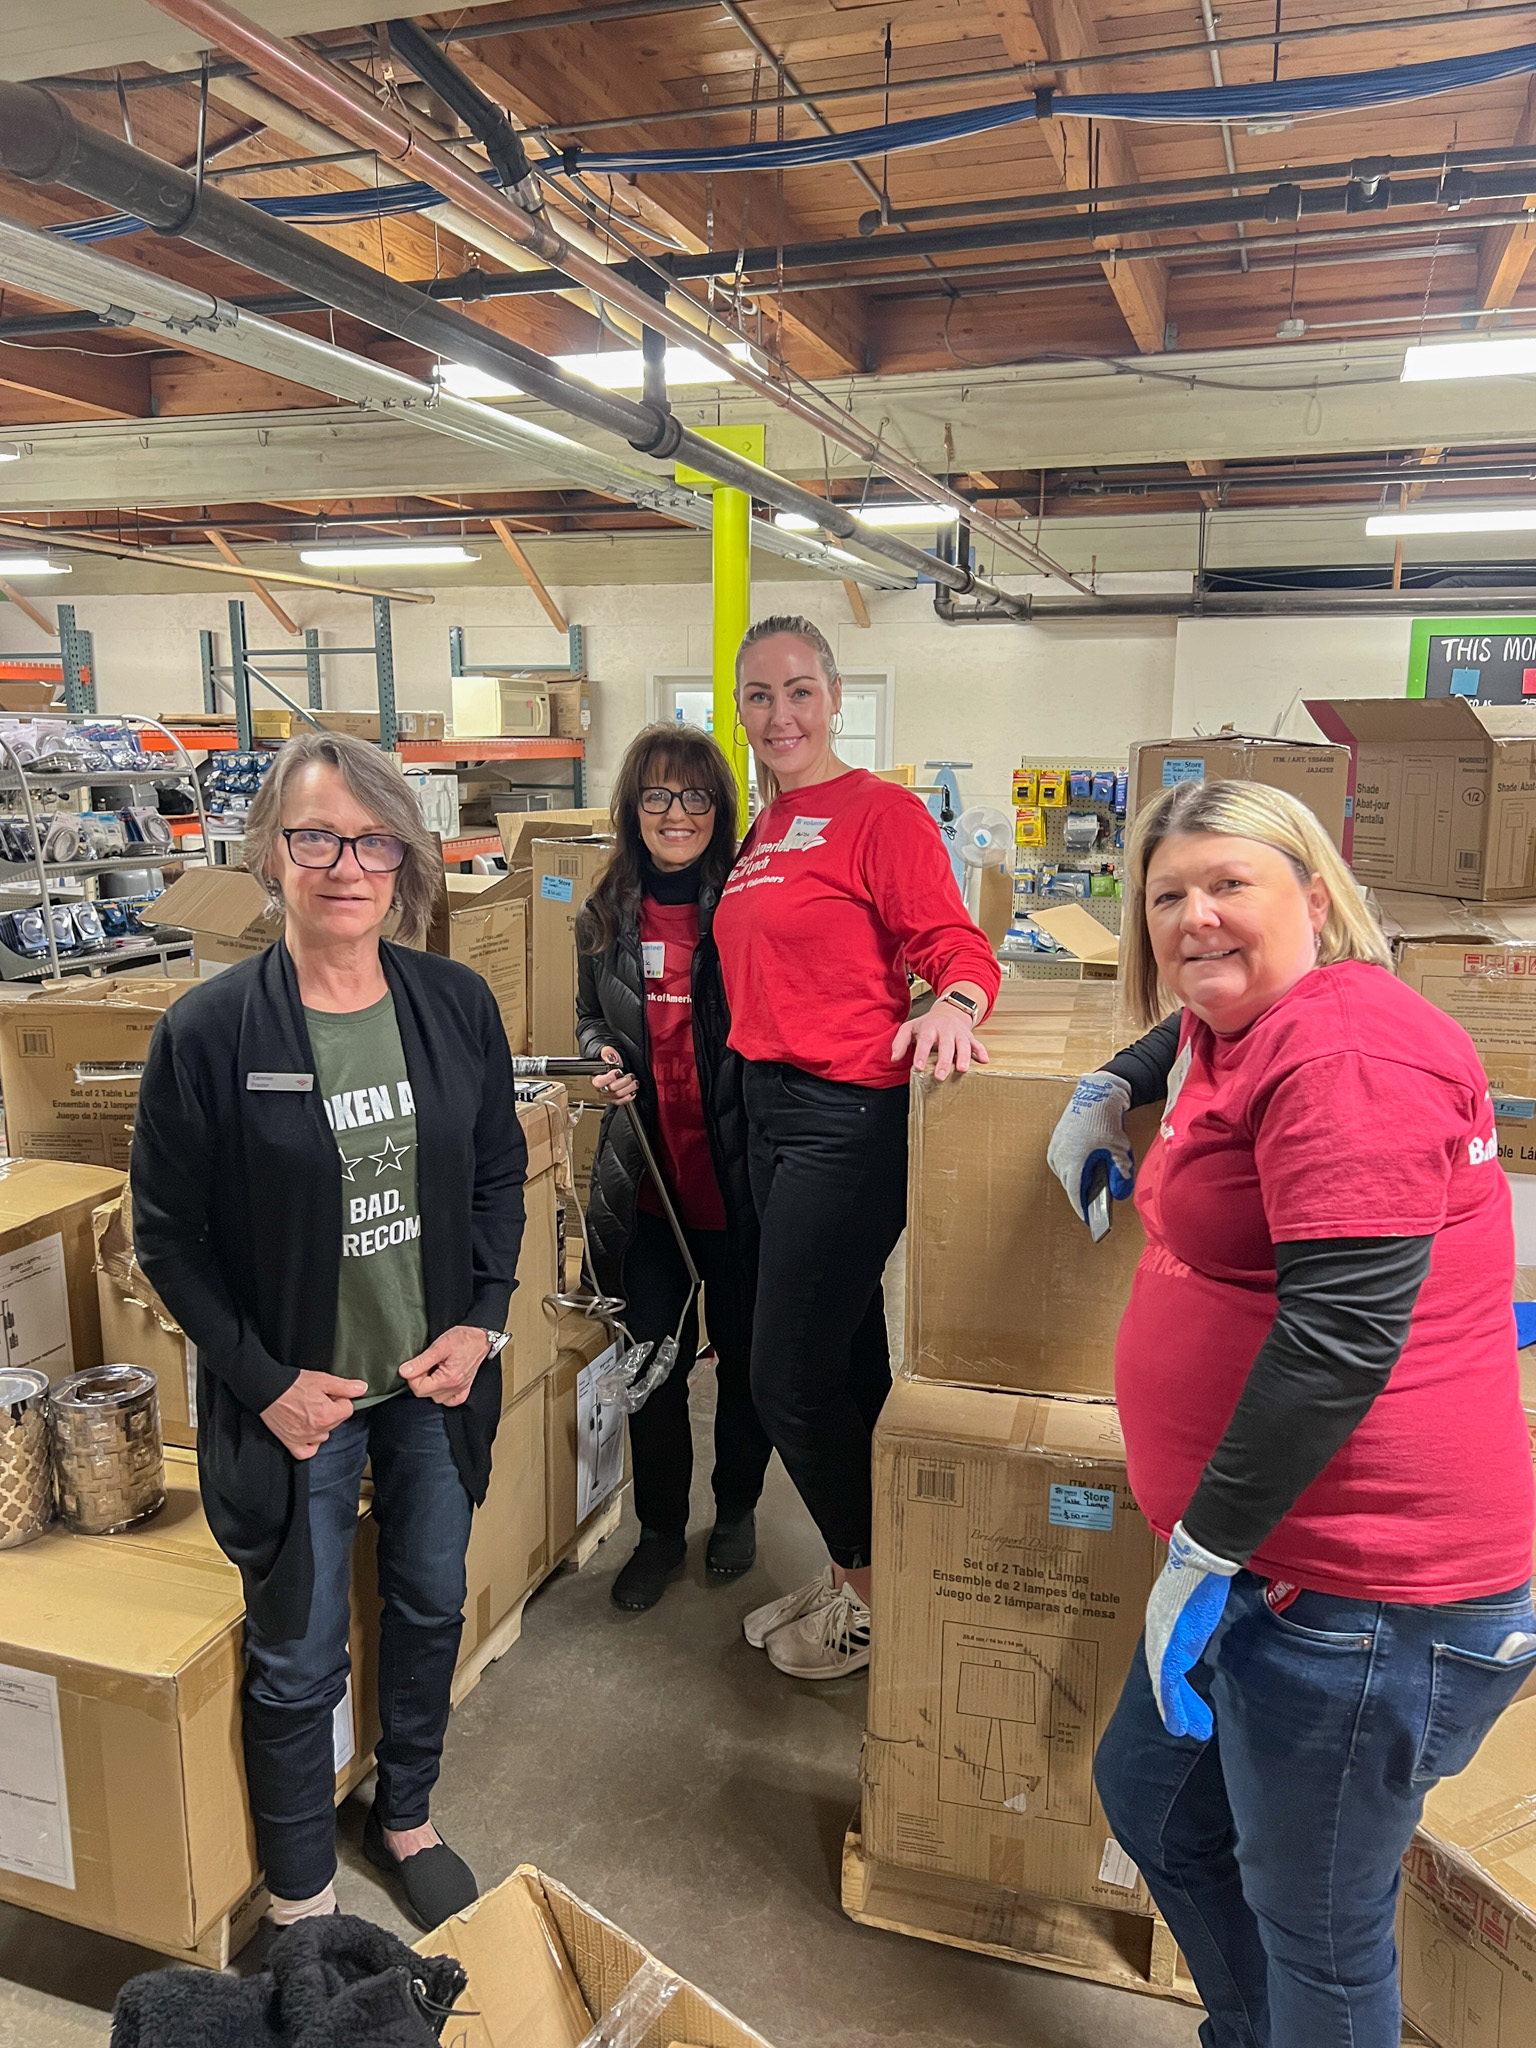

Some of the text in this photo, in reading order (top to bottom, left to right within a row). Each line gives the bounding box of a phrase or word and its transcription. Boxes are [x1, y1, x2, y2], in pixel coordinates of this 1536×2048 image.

[1441, 637, 1536, 662] THIS MO
[1357, 783, 1379, 794] Shade
[1497, 783, 1517, 792] Shade
[1467, 792, 1480, 802] 1/2
[1356, 798, 1390, 812] Abat-jour
[1355, 813, 1384, 824] Pantalla
[70, 1089, 83, 1097] Set
[85, 1089, 93, 1097] of
[52, 1100, 90, 1109] Ensemble
[1072, 1106, 1081, 1114] XL
[56, 1112, 80, 1120] Juego
[1521, 1146, 1536, 1160] Lá
[350, 1189, 405, 1225] BAD.
[1084, 1491, 1110, 1502] Store
[1120, 1501, 1139, 1510] JA2
[963, 1558, 1089, 1586] Set of 2 Table Lamps
[933, 1569, 1121, 1604] Ensemble de 2 lampes de table
[936, 1586, 1116, 1620] Juego de 2 lámparas de mesa
[1480, 1934, 1520, 1972] Lámpara
[1522, 1969, 1534, 1983] de
